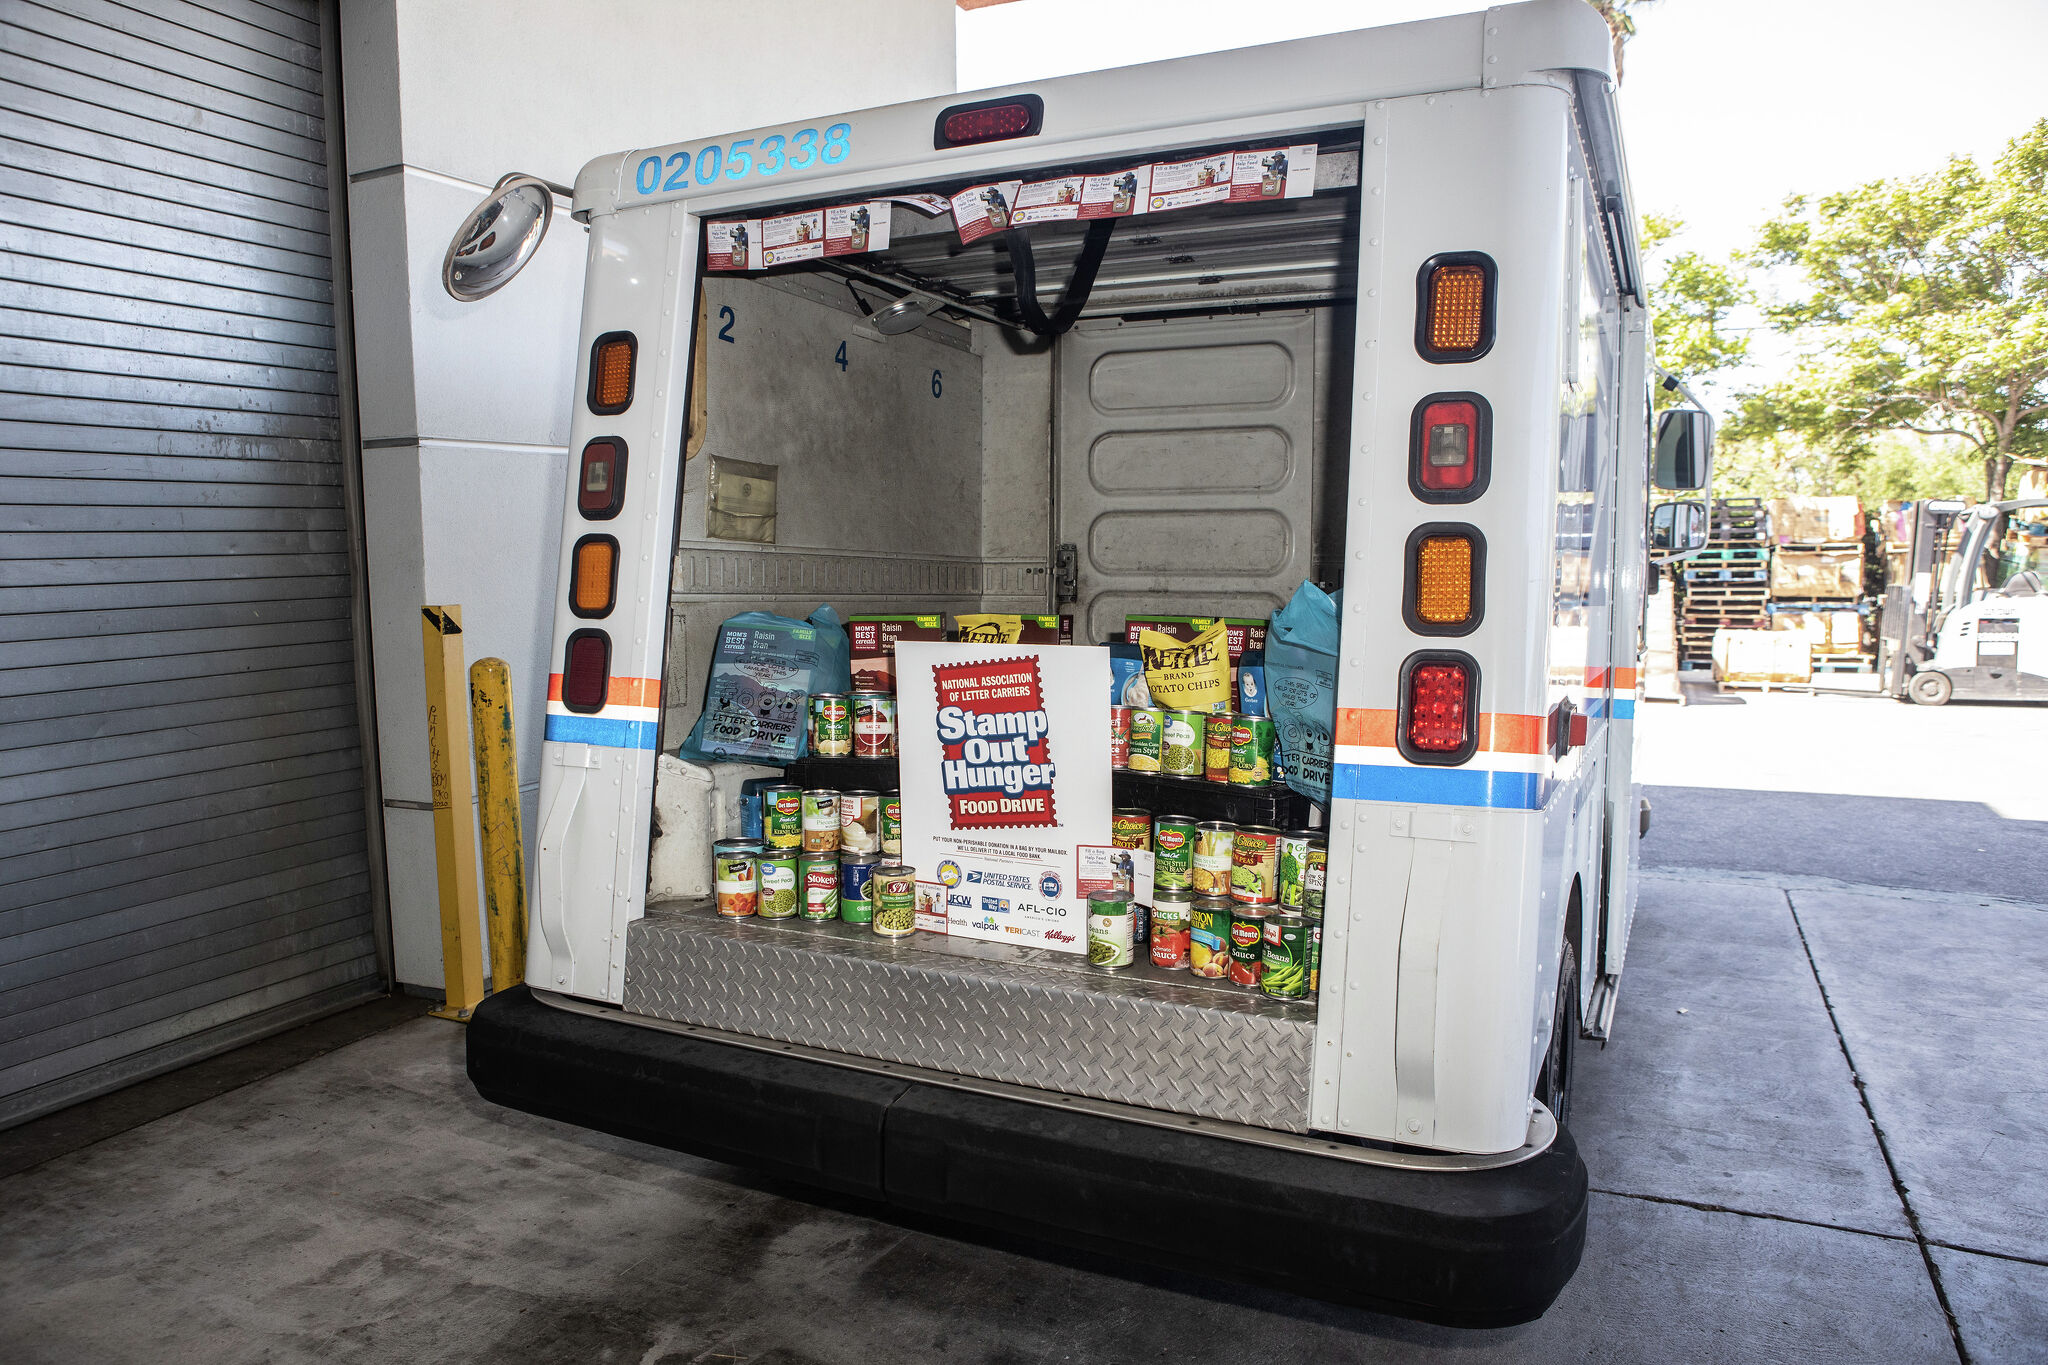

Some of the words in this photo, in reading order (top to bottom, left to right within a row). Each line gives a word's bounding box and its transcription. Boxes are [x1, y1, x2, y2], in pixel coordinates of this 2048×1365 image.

[636, 122, 852, 195] 0205338
[718, 306, 735, 343] 2
[835, 340, 848, 372] 4
[931, 370, 943, 399] 6
[882, 623, 902, 632] Raisin
[1157, 624, 1177, 634] Raisin
[725, 637, 746, 645] BEST
[754, 630, 775, 641] Raisin
[752, 639, 769, 650] Bran
[942, 677, 980, 690] NATIONAL
[981, 672, 1033, 686] ASSOCIATION
[1163, 671, 1195, 681] BRAND
[1187, 678, 1221, 691] CHIPS
[949, 692, 959, 702] OF
[962, 688, 990, 700] LETTER
[991, 686, 1031, 698] CARRIERS
[712, 712, 747, 726] LETTER
[750, 719, 795, 732] CARRIERS'
[937, 706, 1048, 745] Stamp
[713, 723, 741, 735] FOOD
[749, 729, 787, 744] DRIVE
[962, 736, 1030, 764] Out
[1143, 747, 1158, 755] Style
[1238, 761, 1253, 769] CORN
[942, 760, 1055, 798] Hunger
[1303, 768, 1331, 785] DRIVE
[959, 799, 998, 814] FOOD
[1000, 798, 1045, 812] DRIVE
[1117, 819, 1144, 830] Choice
[1167, 836, 1184, 844] Monte
[1237, 834, 1264, 849] Choice
[953, 838, 988, 848] NON-PERISHABLE
[987, 842, 1010, 850] DONATION
[1047, 848, 1069, 856] MAILBOX.
[970, 845, 987, 853] DELIVER
[1239, 857, 1254, 865] PEAS
[1169, 865, 1186, 873] BEANS
[983, 878, 1008, 887] POSTAL
[984, 871, 1008, 880] UNITED
[1008, 874, 1030, 883] STATES
[982, 896, 998, 906] United
[988, 904, 998, 912] Way
[1017, 903, 1067, 917] AFL-CIO
[1152, 906, 1178, 920] GLICKS
[972, 920, 1000, 931] valpak
[1192, 910, 1213, 928] SSION
[1004, 925, 1040, 937] VERICAST
[1044, 929, 1077, 943] Kellogg's
[1239, 929, 1258, 939] Monte
[1152, 947, 1178, 960] Sauce
[1231, 948, 1256, 960] Sauce
[1266, 950, 1290, 963] Beans
